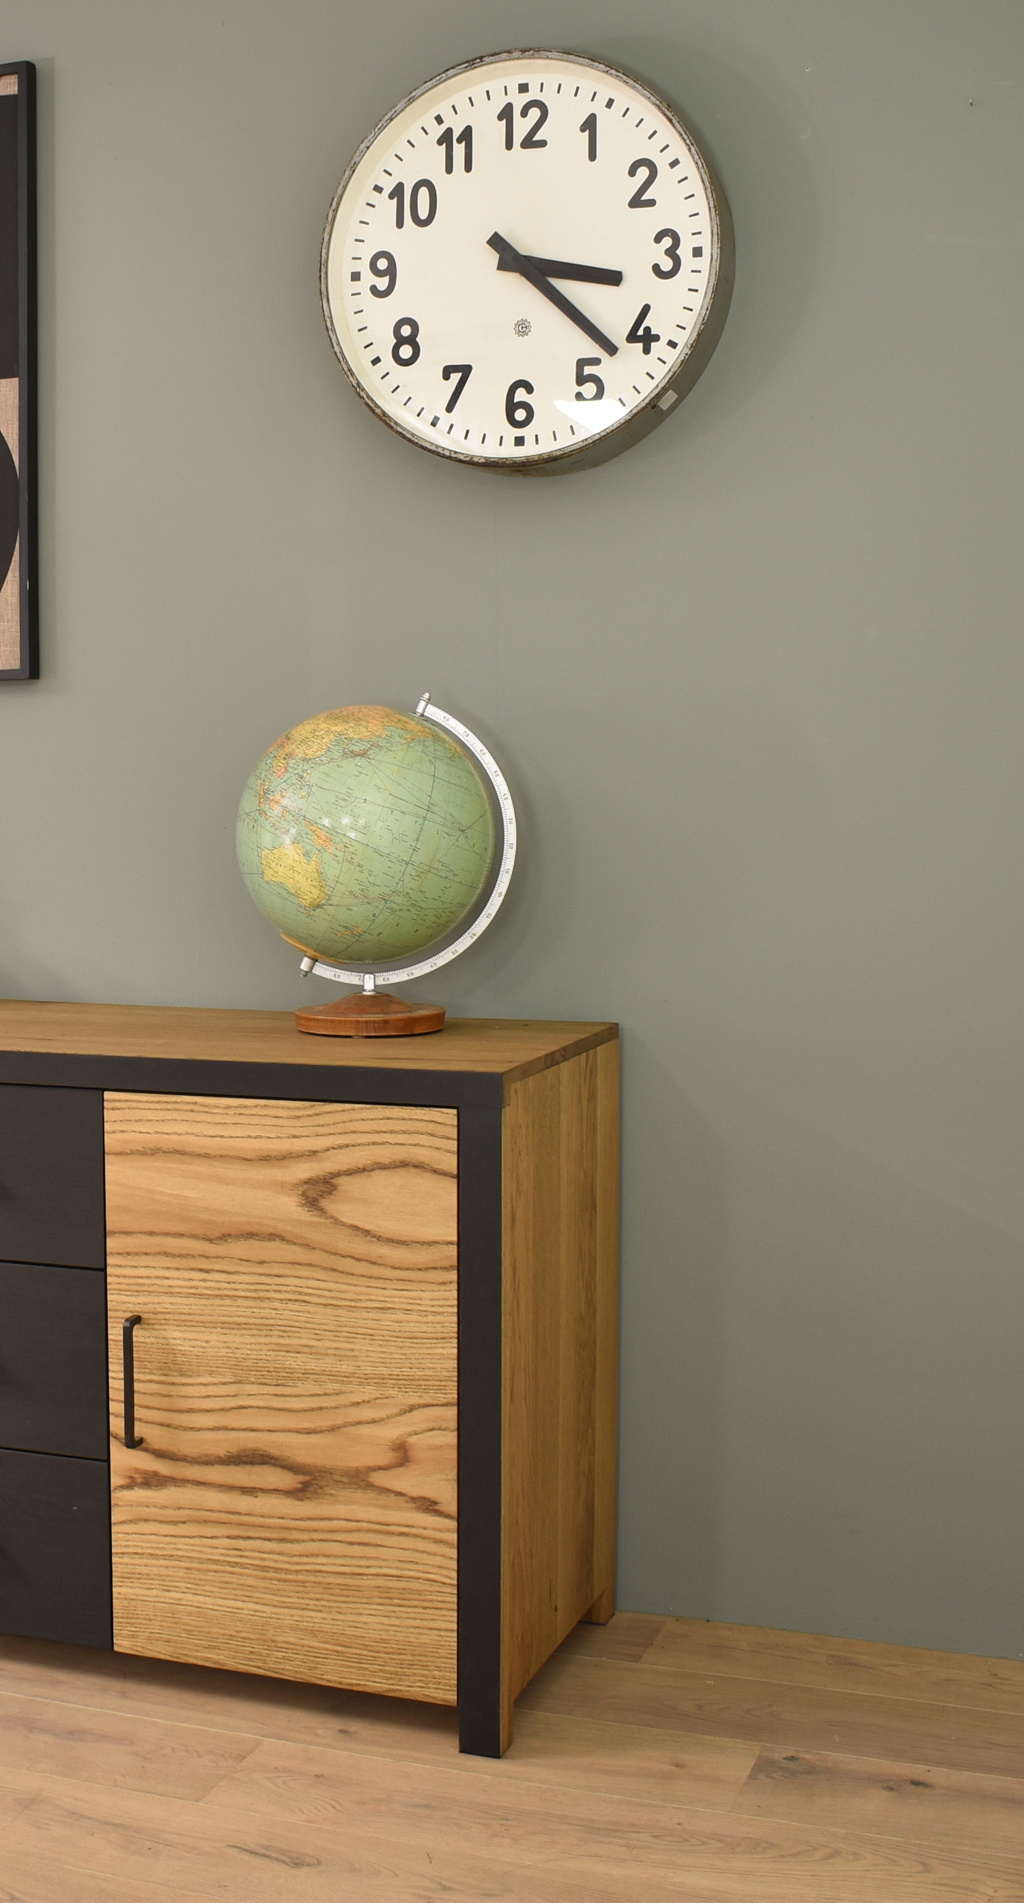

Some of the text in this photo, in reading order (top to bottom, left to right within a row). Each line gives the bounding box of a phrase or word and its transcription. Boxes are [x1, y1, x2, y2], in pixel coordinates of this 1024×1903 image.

[437, 125, 473, 175] 11
[497, 100, 549, 151] 12
[579, 113, 598, 163] 1
[388, 179, 438, 229] 10
[627, 158, 658, 208] 2
[369, 250, 397, 299] 9
[652, 228, 682, 280] 3
[392, 317, 421, 367] 8
[626, 304, 661, 356] 4
[442, 364, 473, 413] 7
[505, 379, 535, 429] 6
[575, 357, 605, 402] 5
